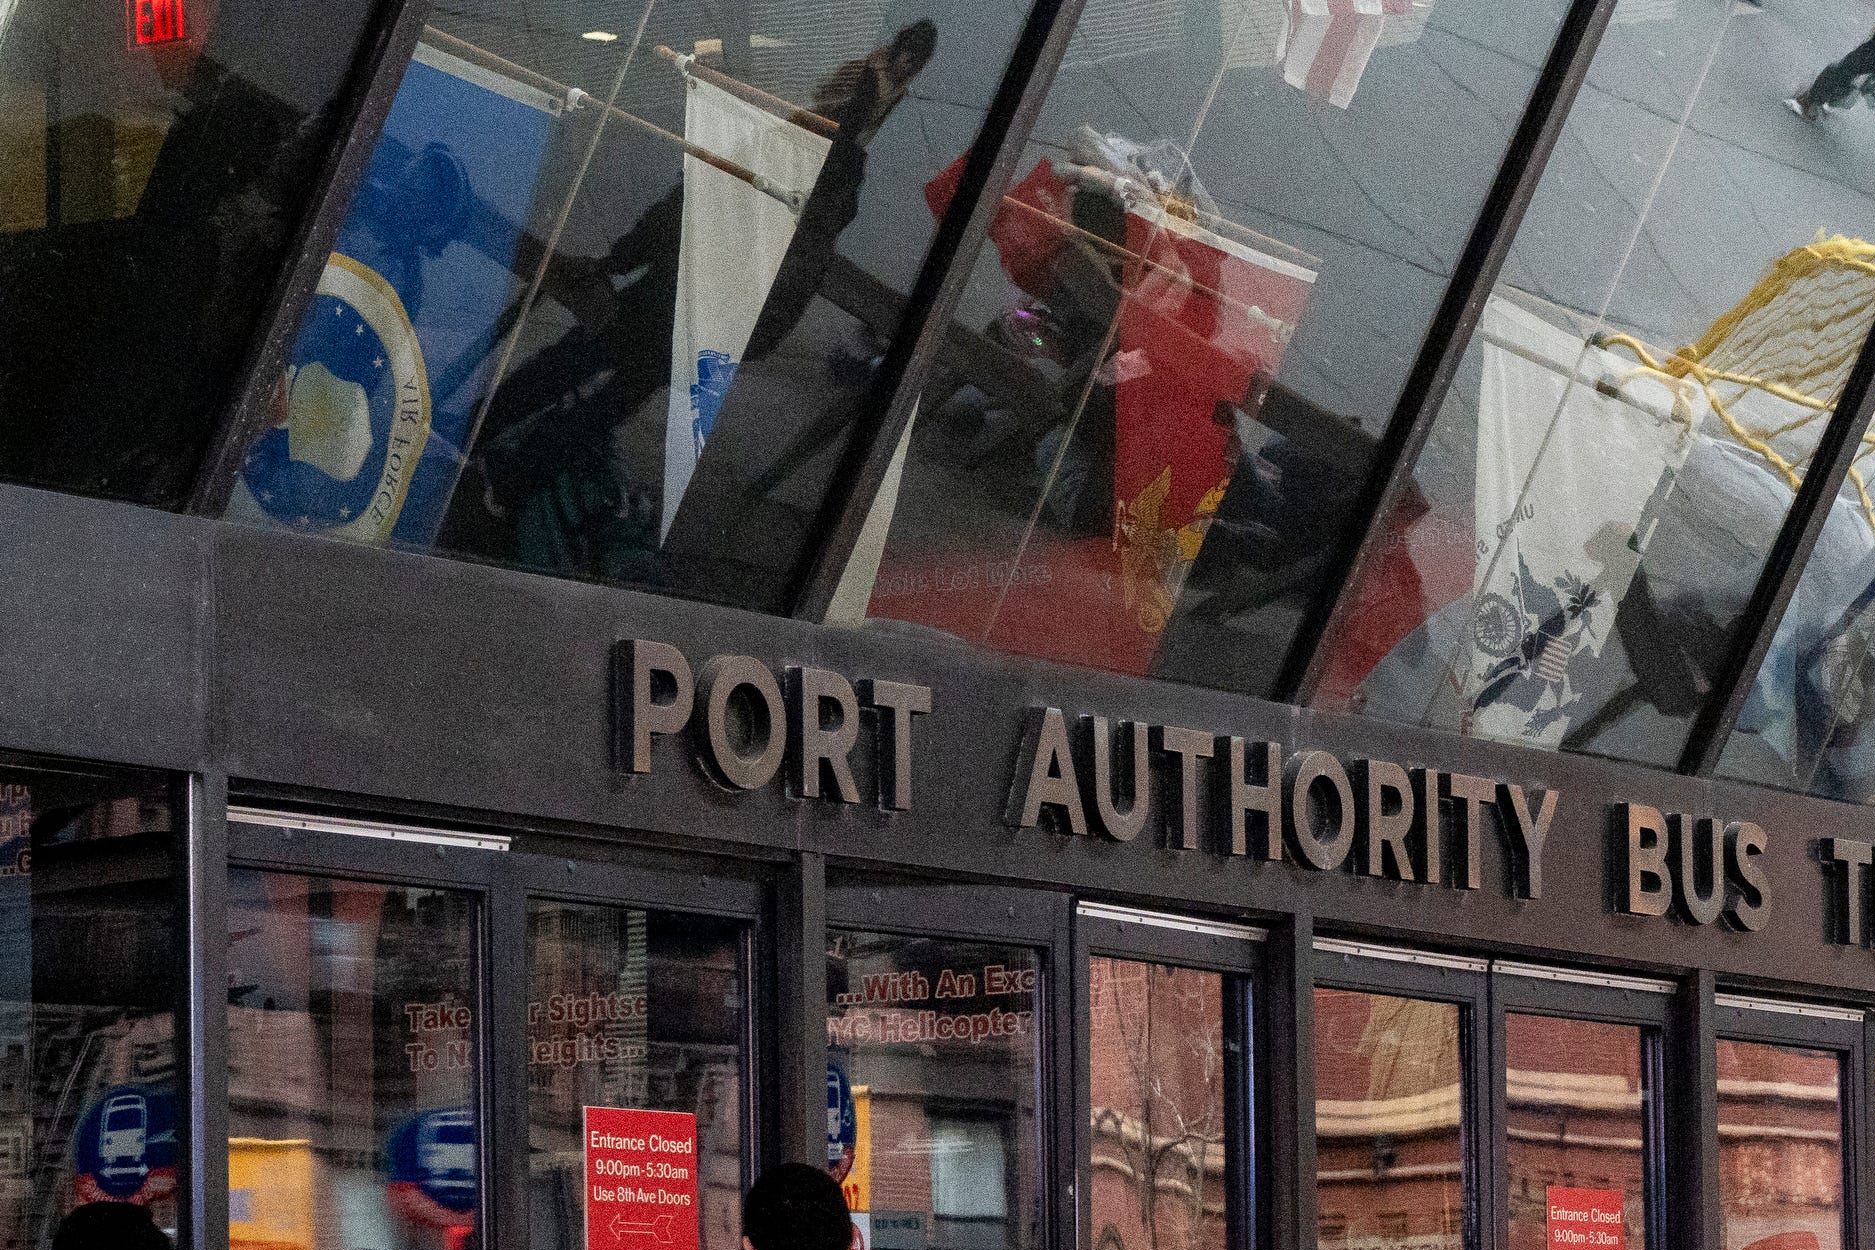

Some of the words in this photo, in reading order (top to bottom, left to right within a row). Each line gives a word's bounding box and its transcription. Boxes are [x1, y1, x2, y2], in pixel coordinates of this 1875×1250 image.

[628, 638, 933, 812] PORT
[1008, 704, 1562, 902] AUTHORITY
[1618, 800, 1772, 934] BUS
[936, 968, 976, 999] An
[404, 1003, 472, 1033] Take
[877, 1007, 1033, 1044] Helicopter
[405, 1040, 438, 1072] To
[590, 1130, 645, 1151] Entrance
[648, 1133, 692, 1154] Closed
[593, 1185, 616, 1203] Use
[617, 1186, 635, 1203] 8th
[636, 1187, 656, 1204] Ave
[658, 1188, 691, 1206] Doors
[1550, 1205, 1588, 1222] Entrance
[1590, 1208, 1622, 1224] Closed
